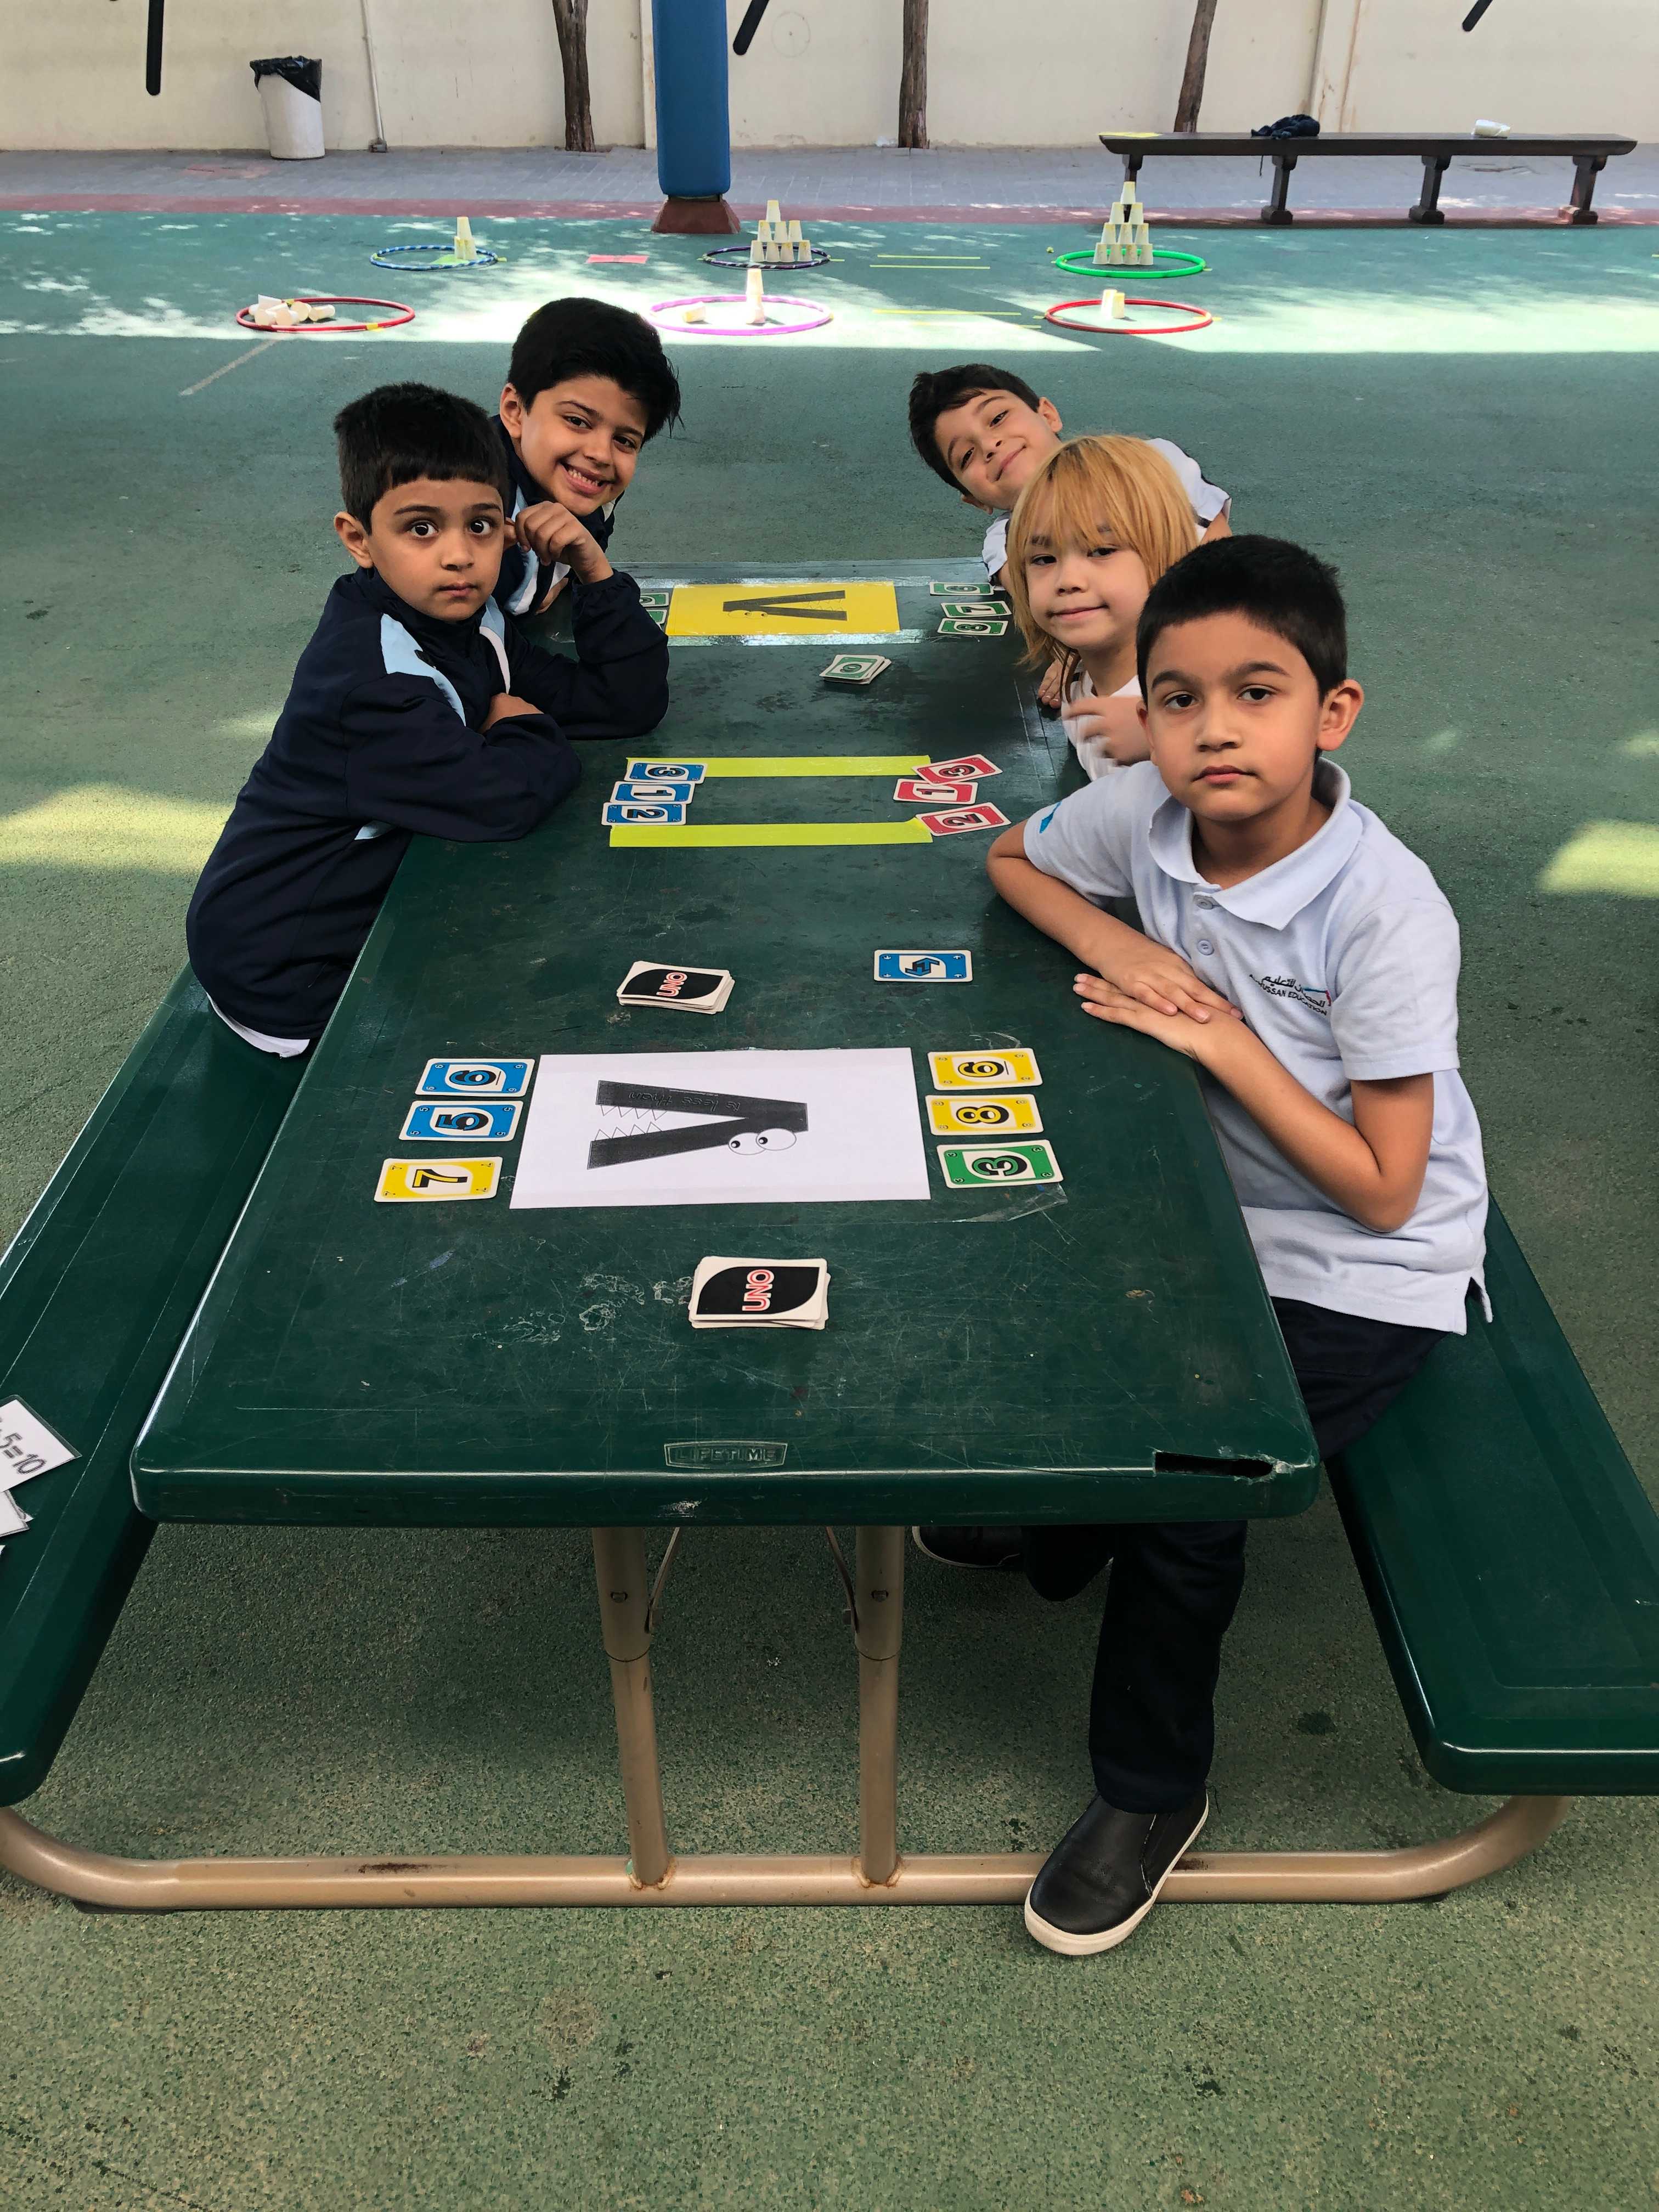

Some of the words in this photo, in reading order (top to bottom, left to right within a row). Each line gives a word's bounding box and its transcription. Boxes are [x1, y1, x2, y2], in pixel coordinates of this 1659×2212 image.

[647, 767, 686, 777] 3
[939, 765, 975, 777] 3
[627, 809, 665, 819] 2
[943, 813, 984, 827] 2
[656, 972, 687, 997] UNO
[958, 1061, 1004, 1077] 6
[449, 1070, 497, 1086] 6
[435, 1112, 489, 1131] 5
[956, 1105, 1009, 1124] 8
[972, 1155, 1028, 1176] 3
[412, 1169, 467, 1188] 7
[742, 1268, 774, 1311] UNO
[675, 1447, 776, 1462] LIFETIME
